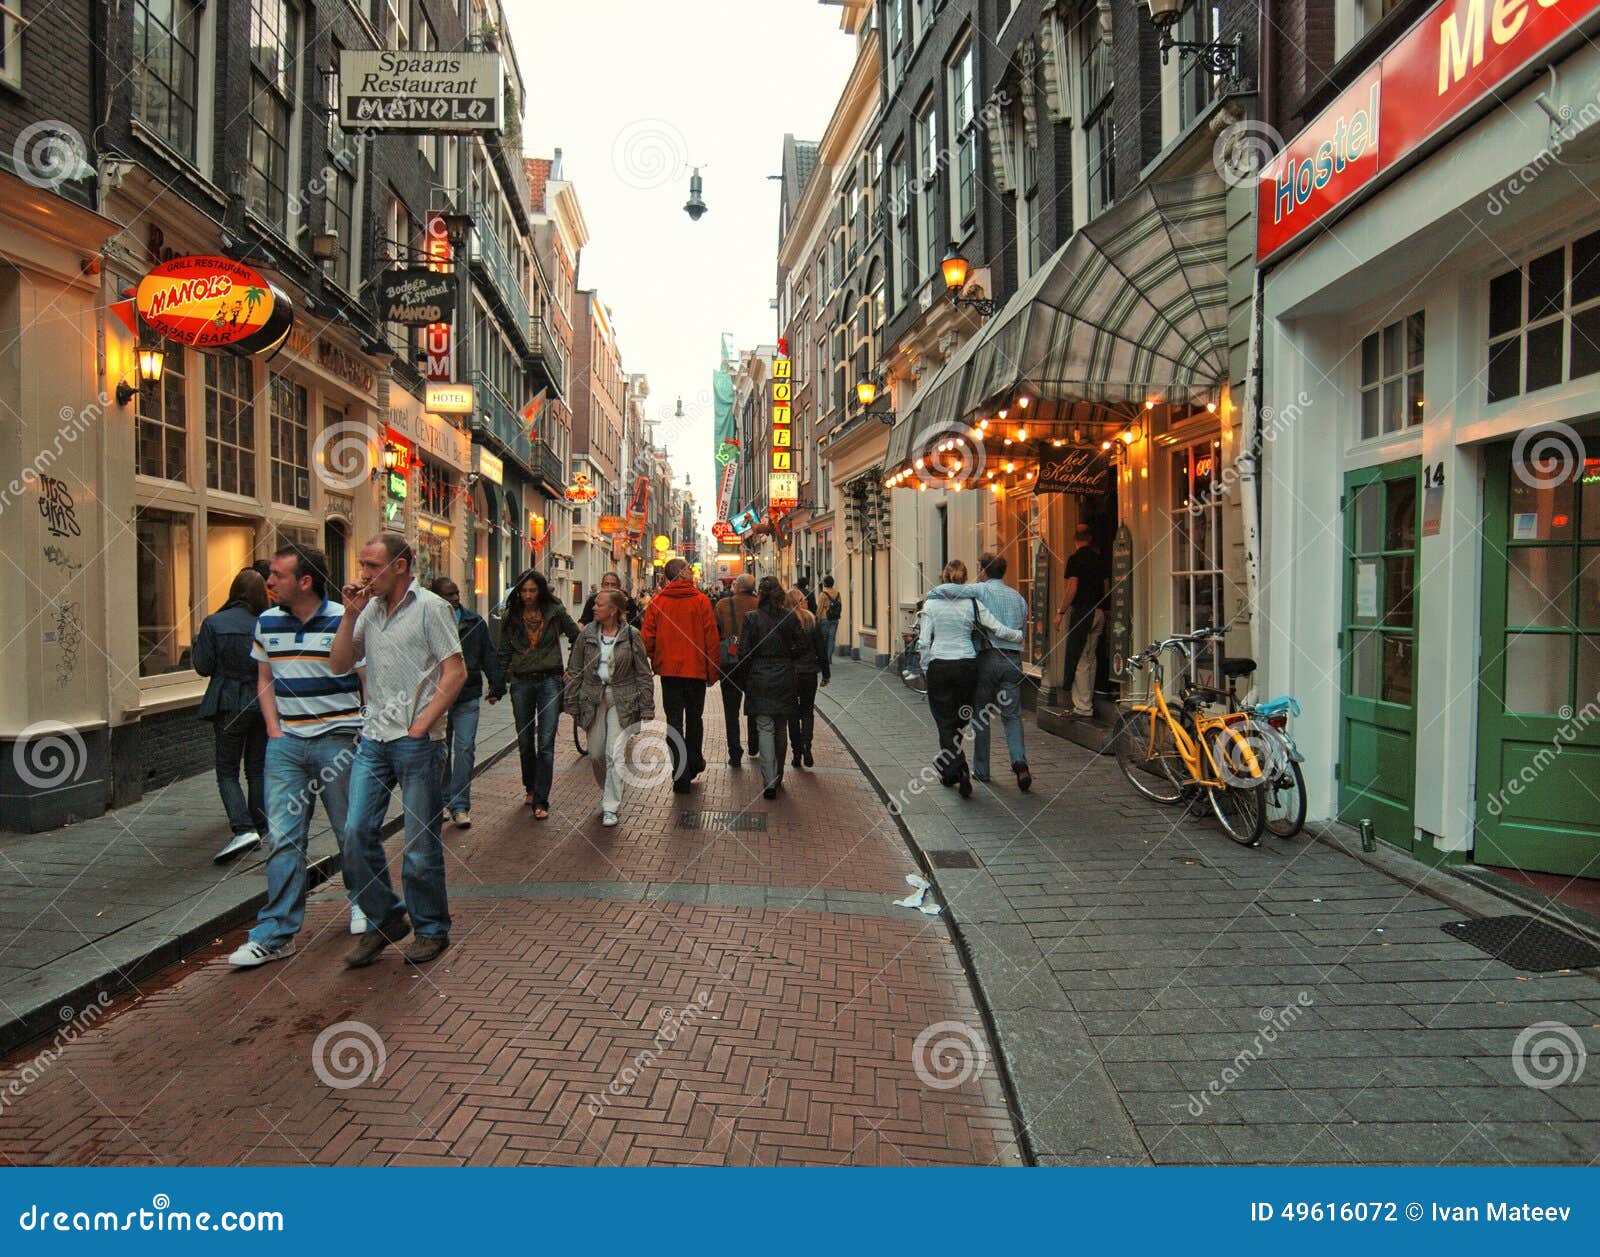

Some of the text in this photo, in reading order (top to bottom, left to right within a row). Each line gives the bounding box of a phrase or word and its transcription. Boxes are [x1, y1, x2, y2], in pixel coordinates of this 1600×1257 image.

[379, 52, 461, 76] Spaans
[360, 73, 478, 95] Restaurant
[356, 98, 488, 120] MANOLO
[1273, 0, 1558, 225] Hostel Me
[167, 259, 252, 281] GRILL RESTAURANT
[147, 275, 232, 319] MANOLO
[154, 320, 232, 344] TAPAS BAR
[432, 393, 466, 404] HOTEL
[775, 362, 790, 467] HOTEL
[1424, 462, 1445, 489] 14
